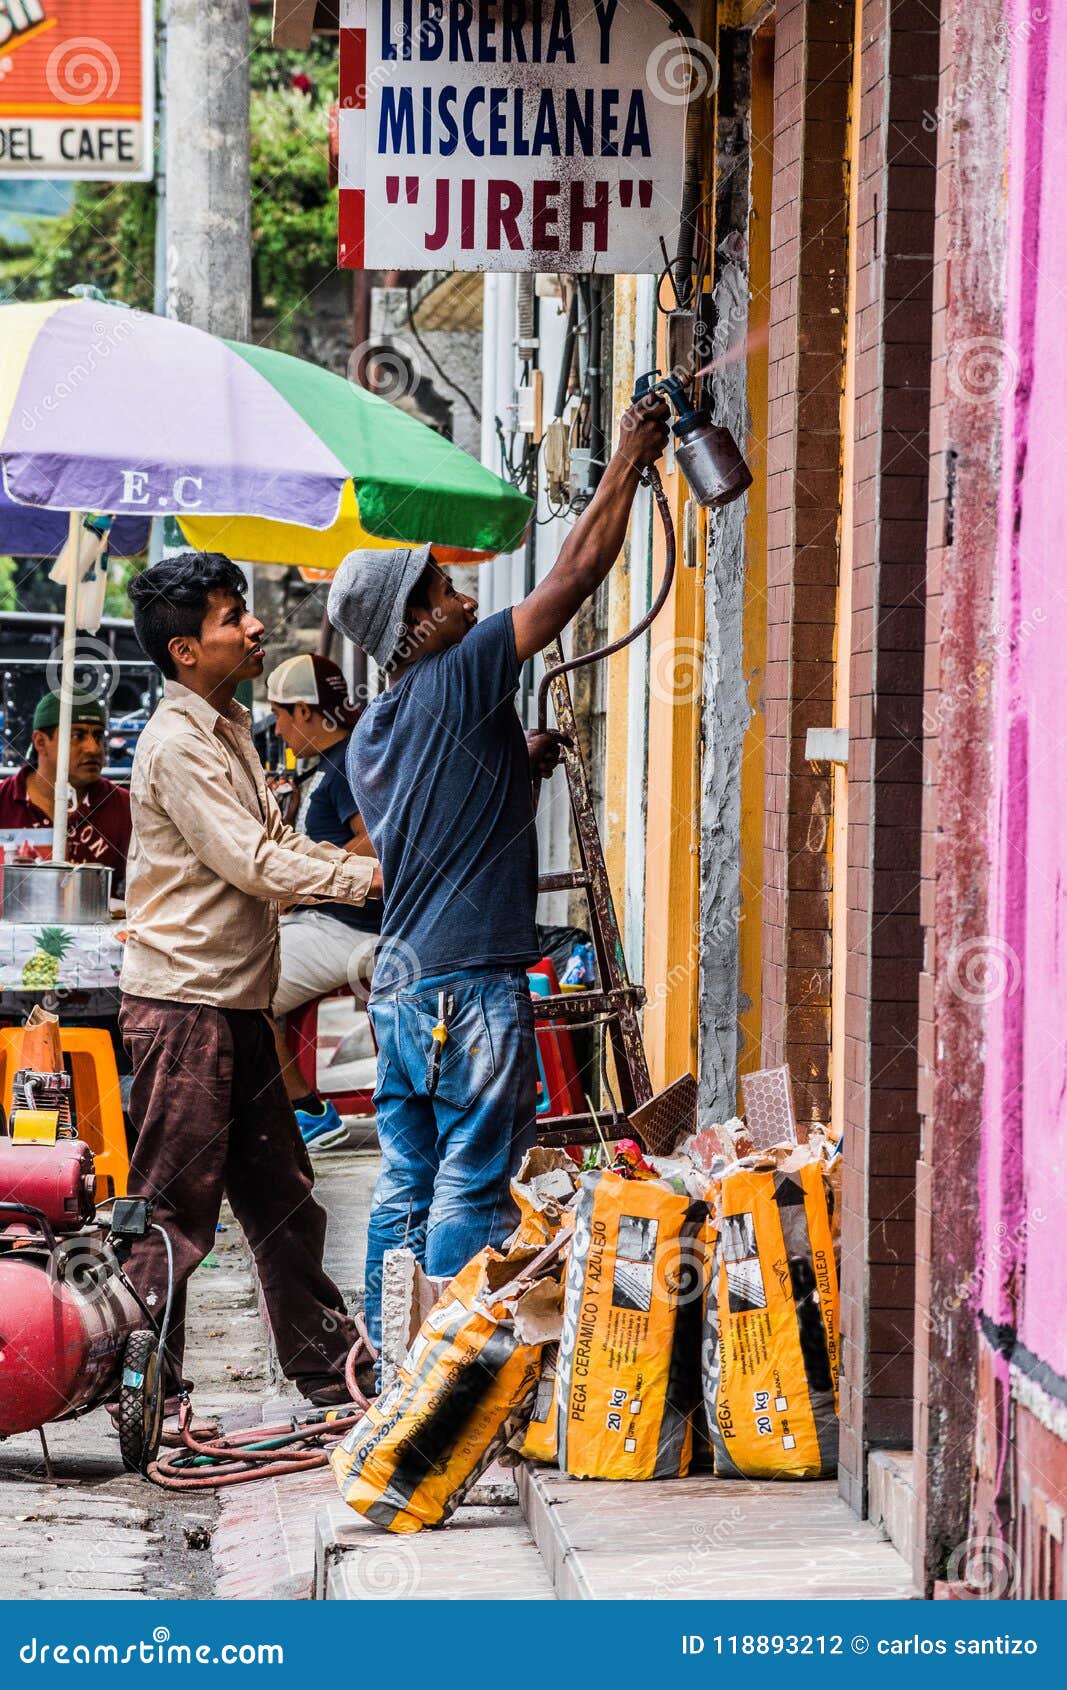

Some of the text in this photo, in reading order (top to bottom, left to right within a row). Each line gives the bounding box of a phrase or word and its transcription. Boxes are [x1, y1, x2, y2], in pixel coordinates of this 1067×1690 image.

[381, 0, 619, 64] LIBRERIA Y
[377, 86, 652, 158] MISCELANEA
[59, 128, 134, 161] CAFE
[385, 175, 653, 252] "JIREH"
[815, 1250, 832, 1294] AZULEJO
[571, 1220, 607, 1422] PEGA CERAMICO Y AZULEJO
[607, 1388, 628, 1432] 20 kg
[718, 1399, 736, 1439] PEGA
[754, 1391, 772, 1434] 20 kg
